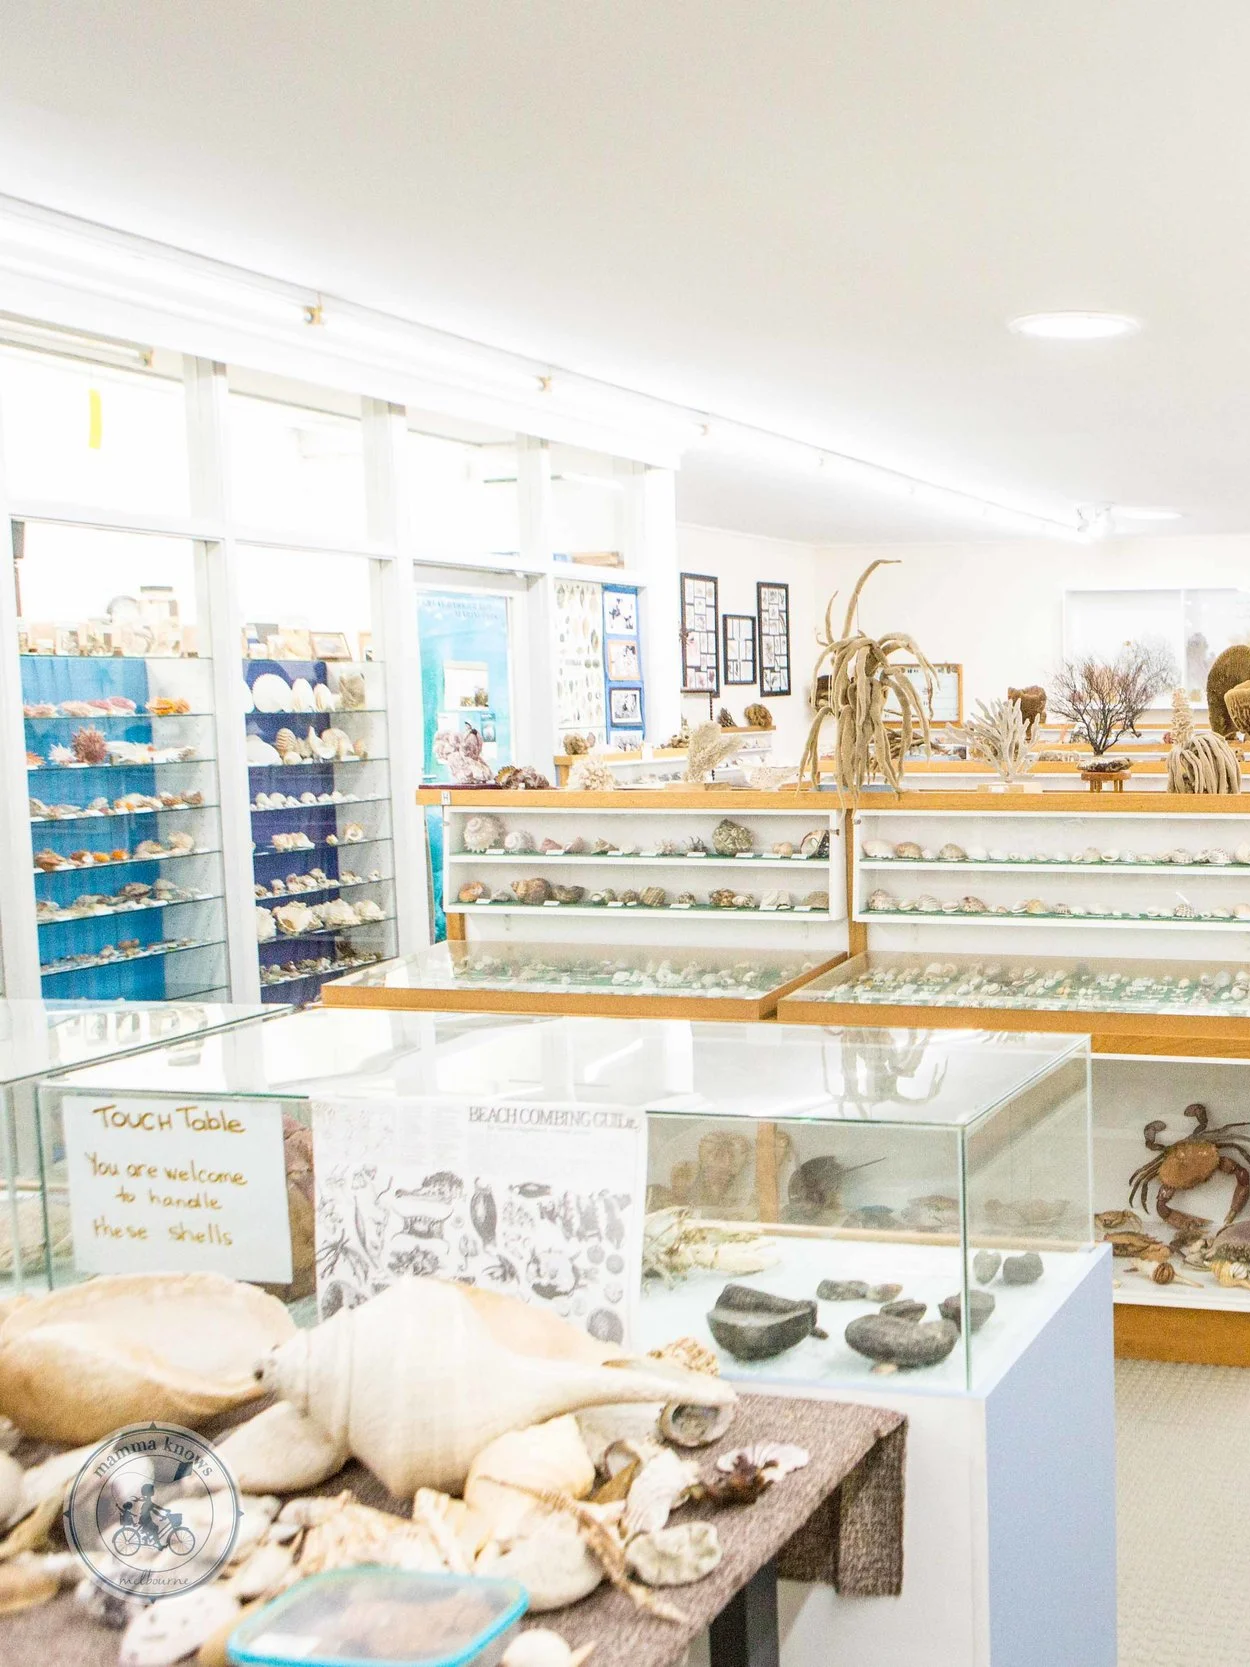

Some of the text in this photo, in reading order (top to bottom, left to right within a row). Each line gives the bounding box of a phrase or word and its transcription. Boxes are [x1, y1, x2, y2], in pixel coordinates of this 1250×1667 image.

[175, 1106, 246, 1133] Table
[468, 1106, 518, 1124] BEACH
[519, 1108, 591, 1127] COMBING
[84, 1152, 248, 1186] You are welcome
[114, 1185, 223, 1210] to handle
[93, 1215, 234, 1247] these shells
